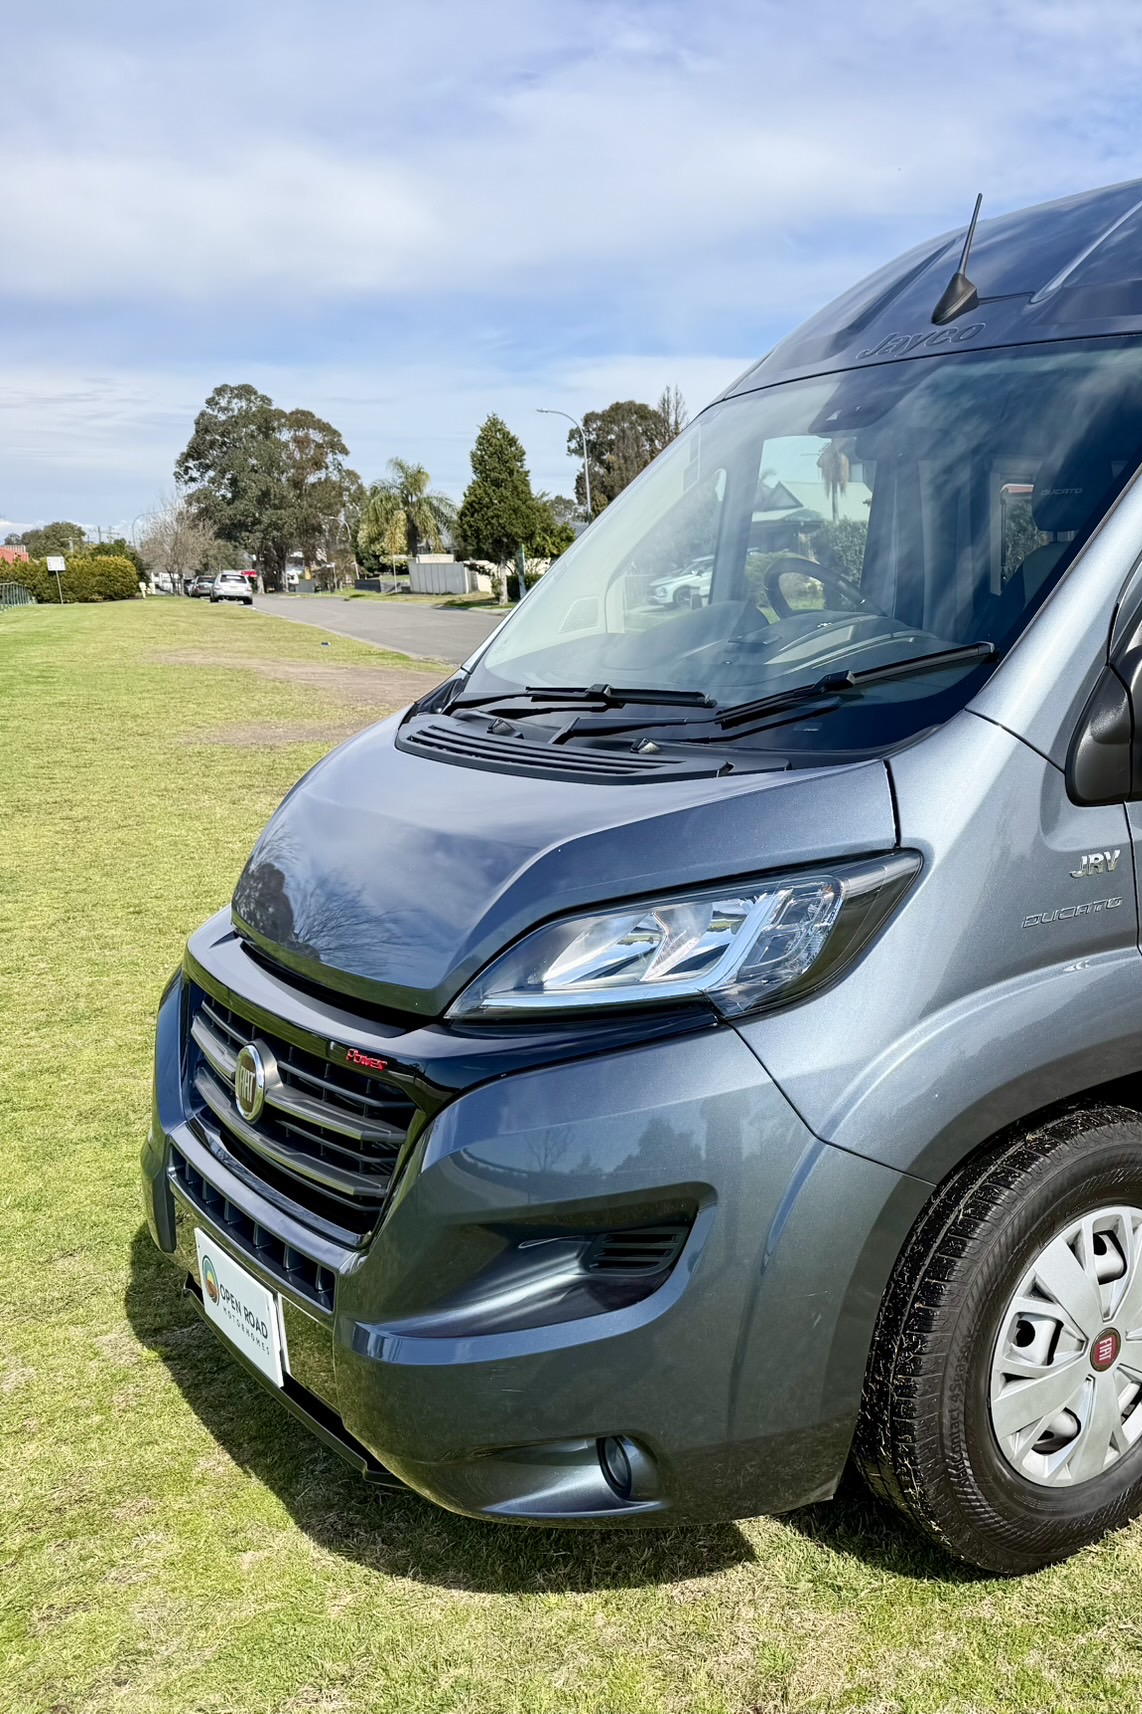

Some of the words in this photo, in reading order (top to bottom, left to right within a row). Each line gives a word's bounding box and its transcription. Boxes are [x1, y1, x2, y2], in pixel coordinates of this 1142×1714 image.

[855, 322, 987, 359] Jayco
[1069, 849, 1121, 878] JRV
[1020, 896, 1123, 929] DUCATO
[239, 1065, 256, 1103] FIAT
[220, 1284, 242, 1317] OPEN
[243, 1305, 268, 1339] ROAD
[1099, 1337, 1113, 1361] FIAT
